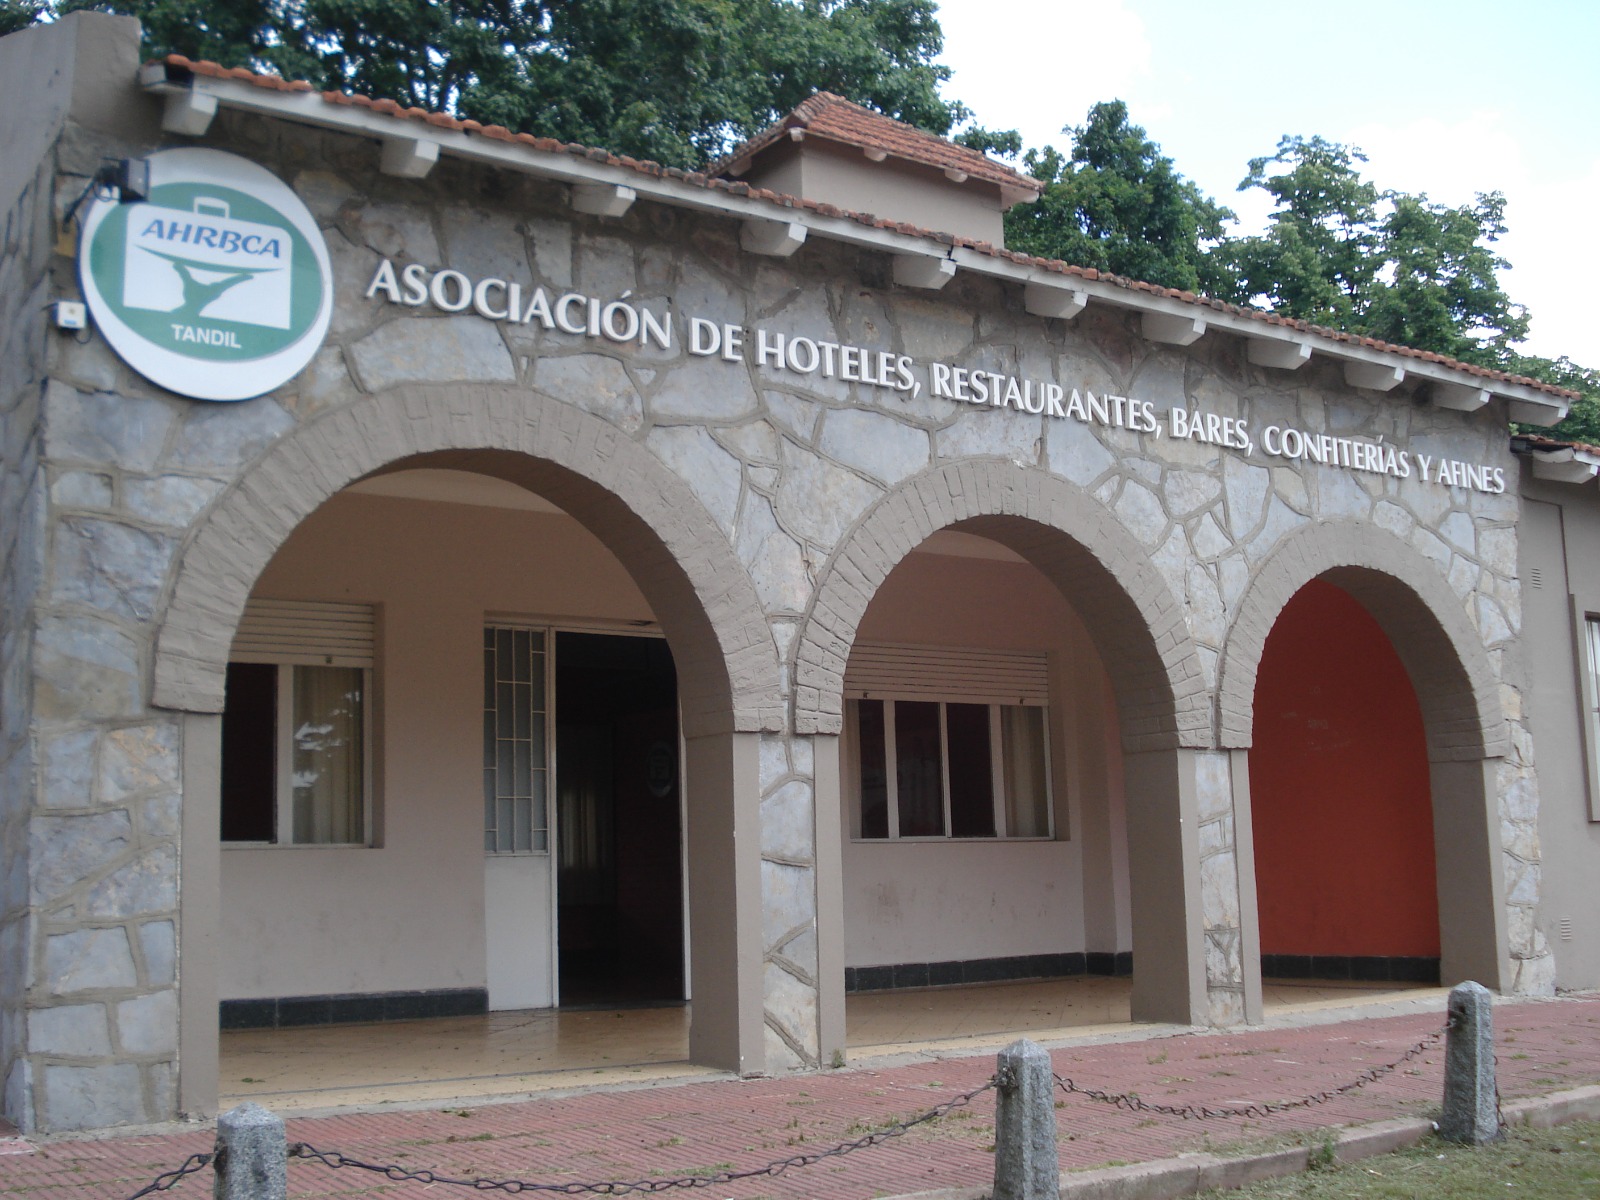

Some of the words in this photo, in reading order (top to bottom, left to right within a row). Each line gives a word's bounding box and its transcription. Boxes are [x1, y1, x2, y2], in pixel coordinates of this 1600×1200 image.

[141, 219, 280, 259] AHRBCA
[171, 323, 242, 349] TANDIL
[365, 259, 672, 349] ASOCIACIÓN
[687, 317, 744, 361] DE
[756, 329, 921, 399] HOTELES,
[930, 361, 1162, 439] RESTAURANTES,
[1169, 407, 1254, 456] BARES,
[1261, 425, 1411, 478] CONFITERÍAS
[1416, 453, 1432, 482] Y
[1436, 458, 1506, 494] AFINES
